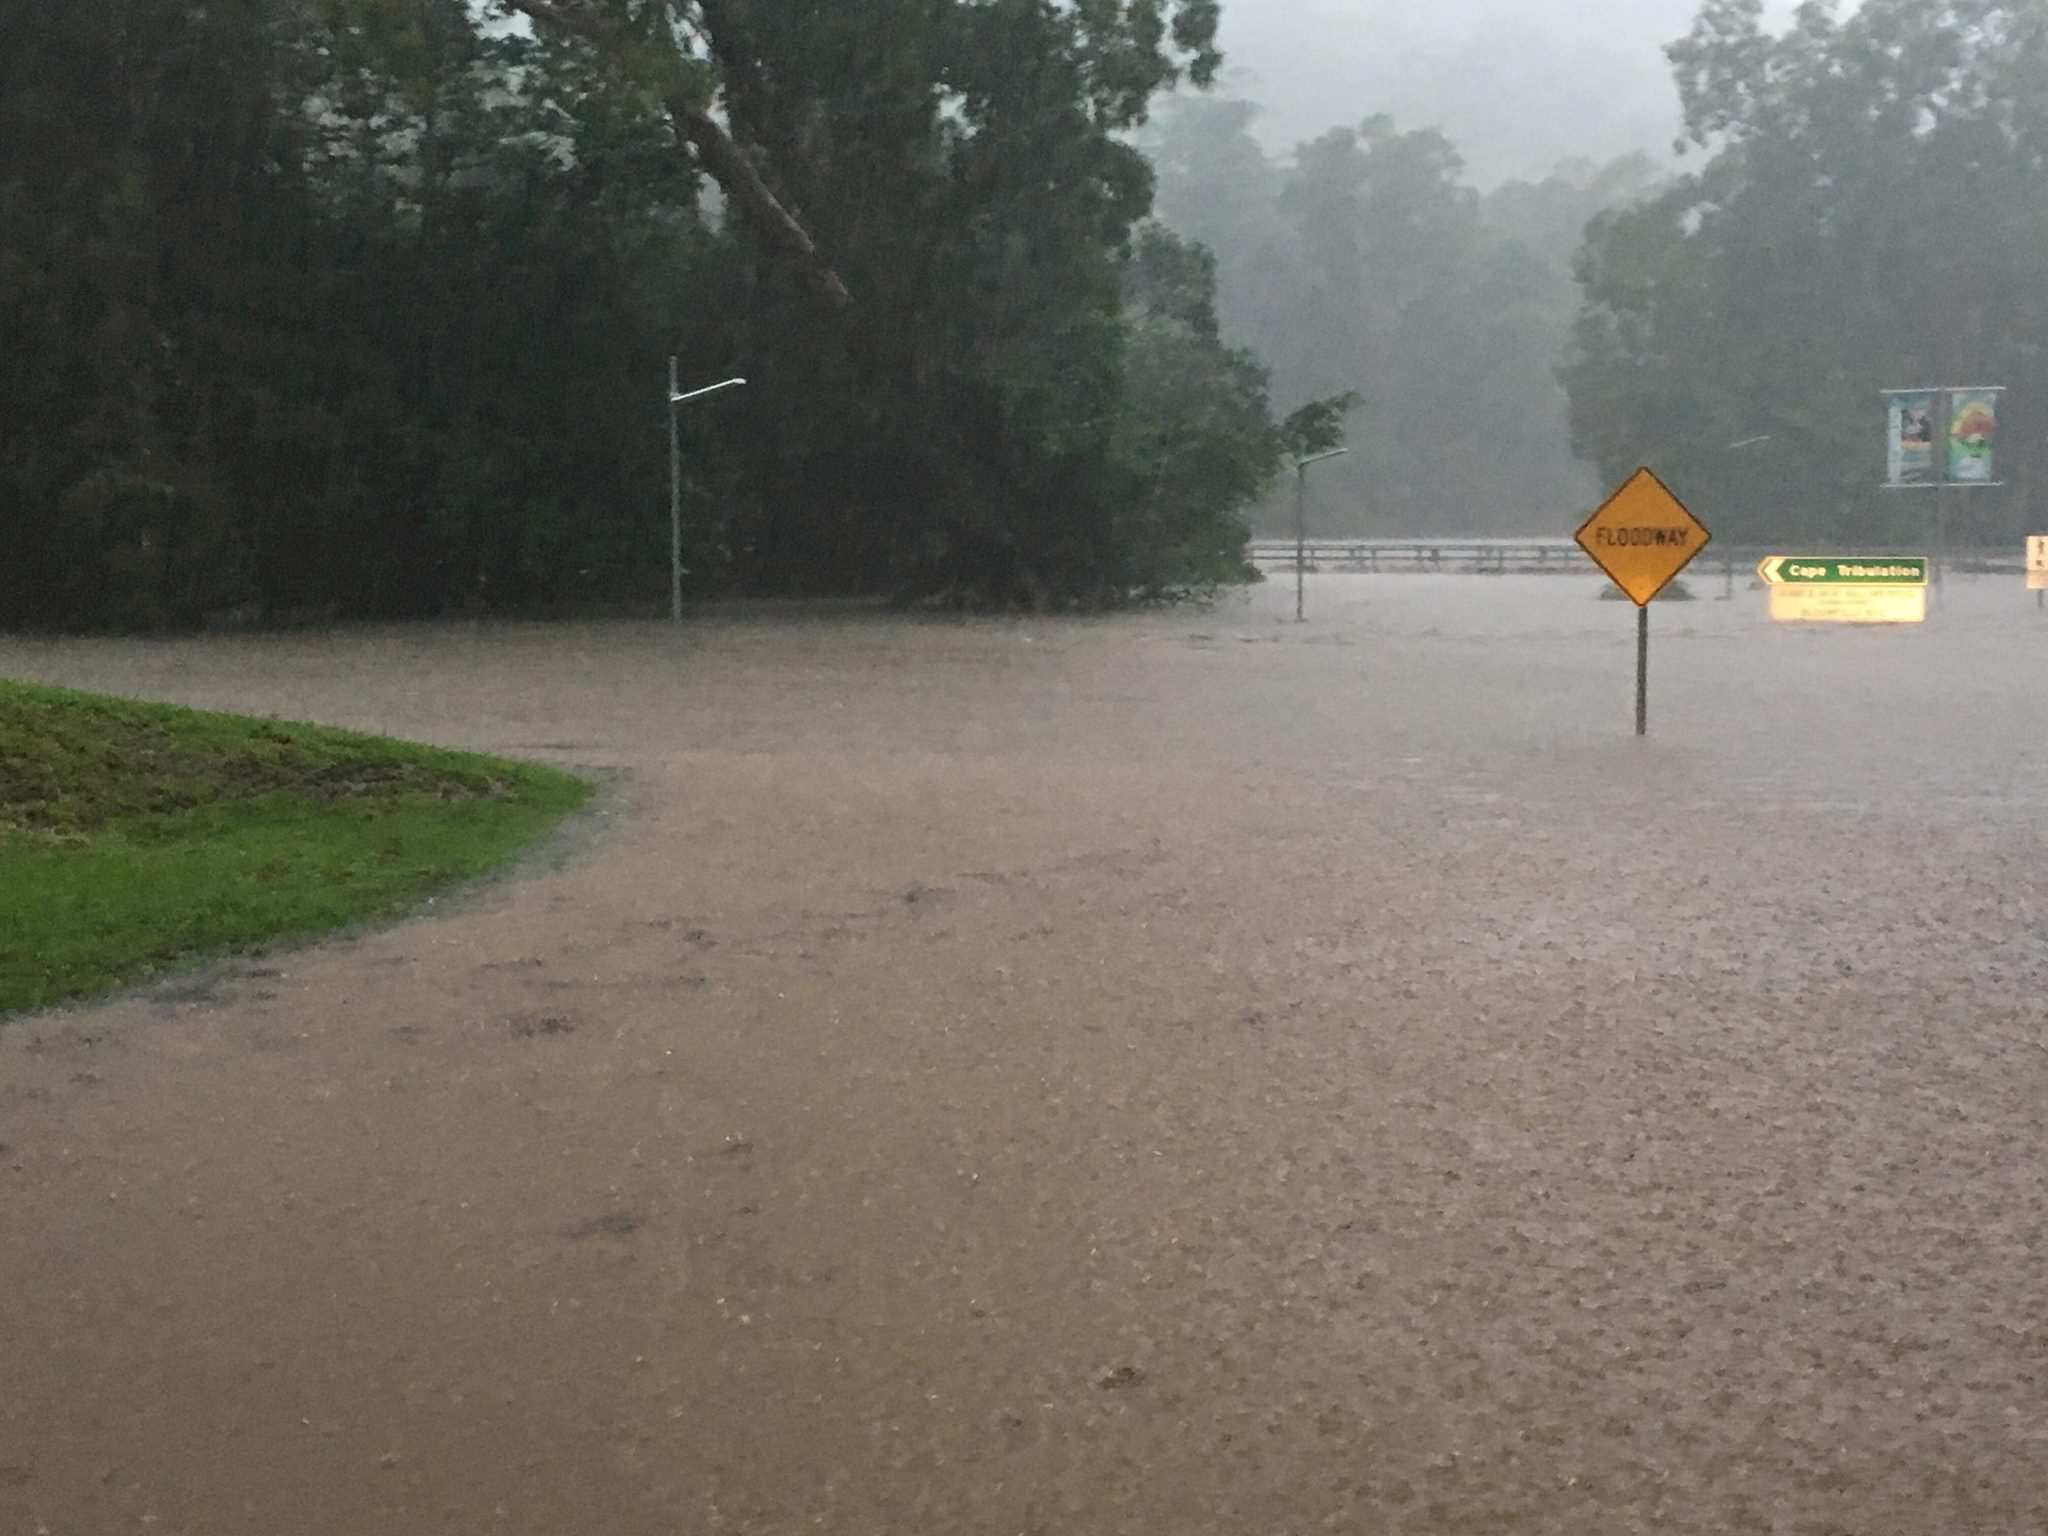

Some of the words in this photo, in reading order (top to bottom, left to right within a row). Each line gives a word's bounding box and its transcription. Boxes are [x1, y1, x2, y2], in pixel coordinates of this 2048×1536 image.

[1596, 527, 1688, 546] FLOODWAY
[1788, 564, 1827, 578] Cape
[1836, 564, 1920, 577] Tribulation
